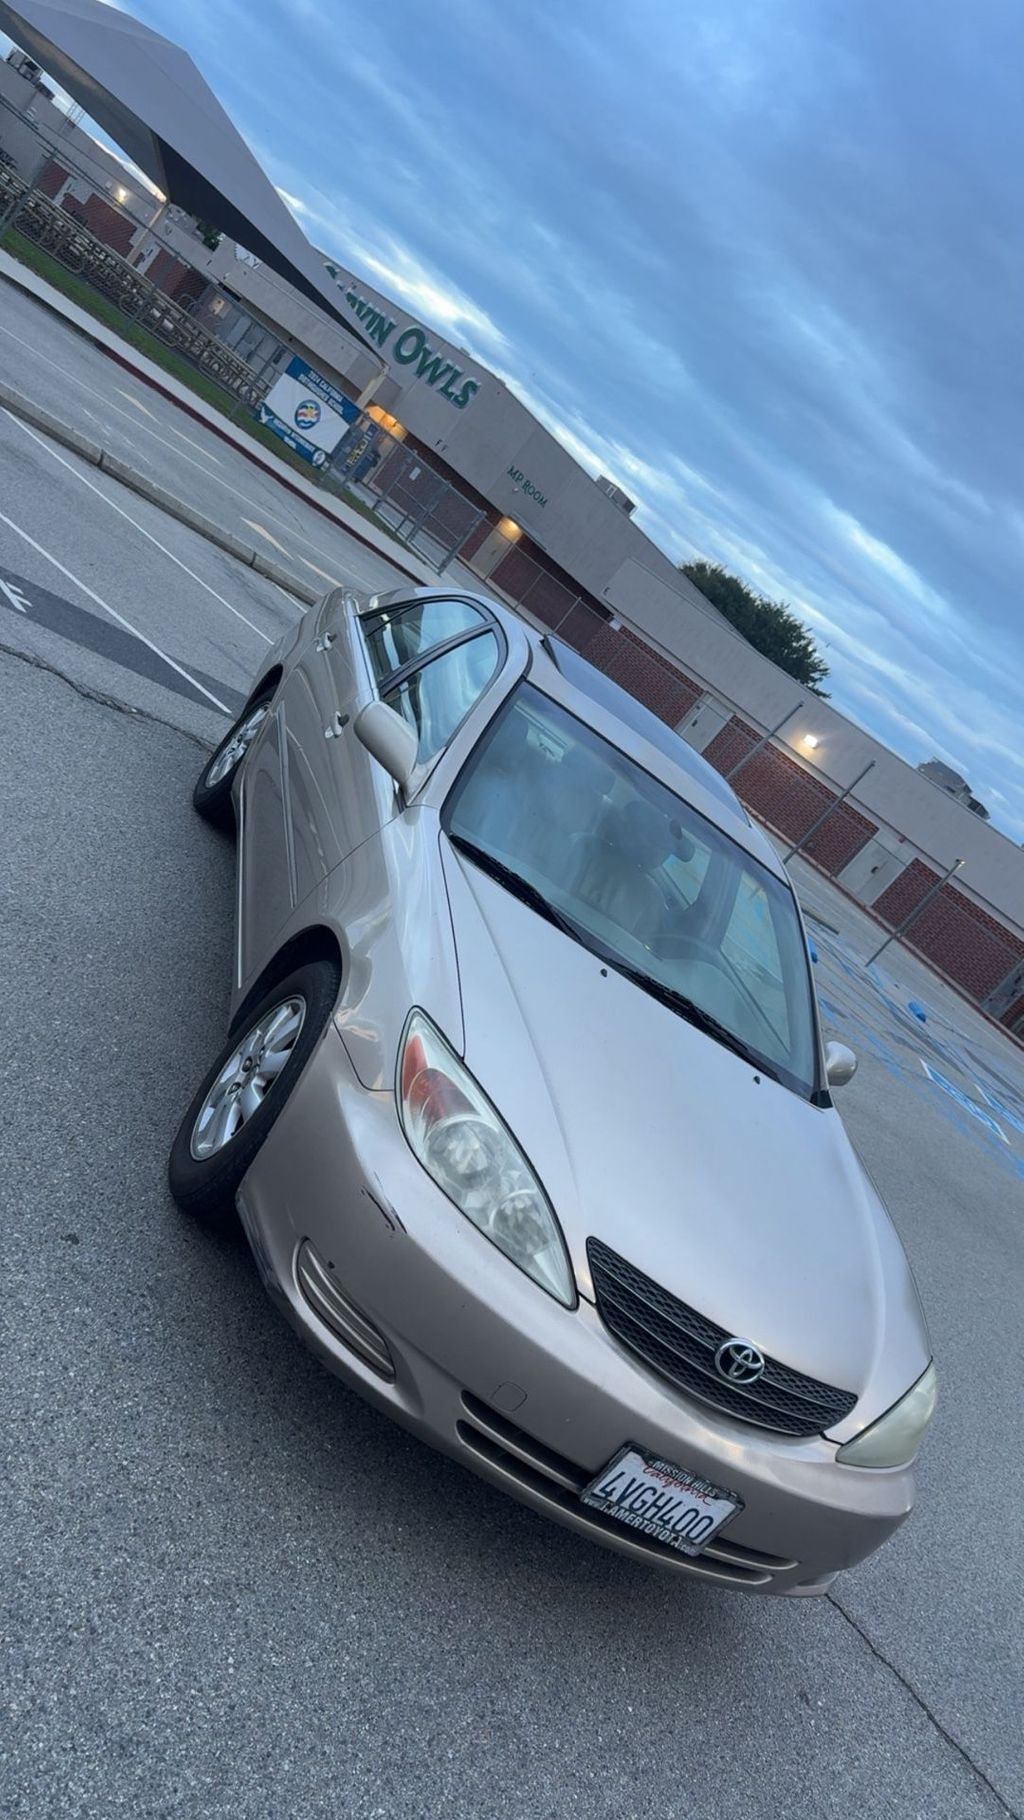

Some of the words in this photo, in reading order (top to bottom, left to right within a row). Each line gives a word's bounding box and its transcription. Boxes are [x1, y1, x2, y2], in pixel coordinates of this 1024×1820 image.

[392, 325, 481, 409] OWLS
[506, 465, 524, 482] MP
[522, 480, 548, 508] ROOM
[599, 1471, 714, 1541] 4VGH400
[652, 1460, 695, 1482] MISSION
[691, 1476, 718, 1497] HILLS
